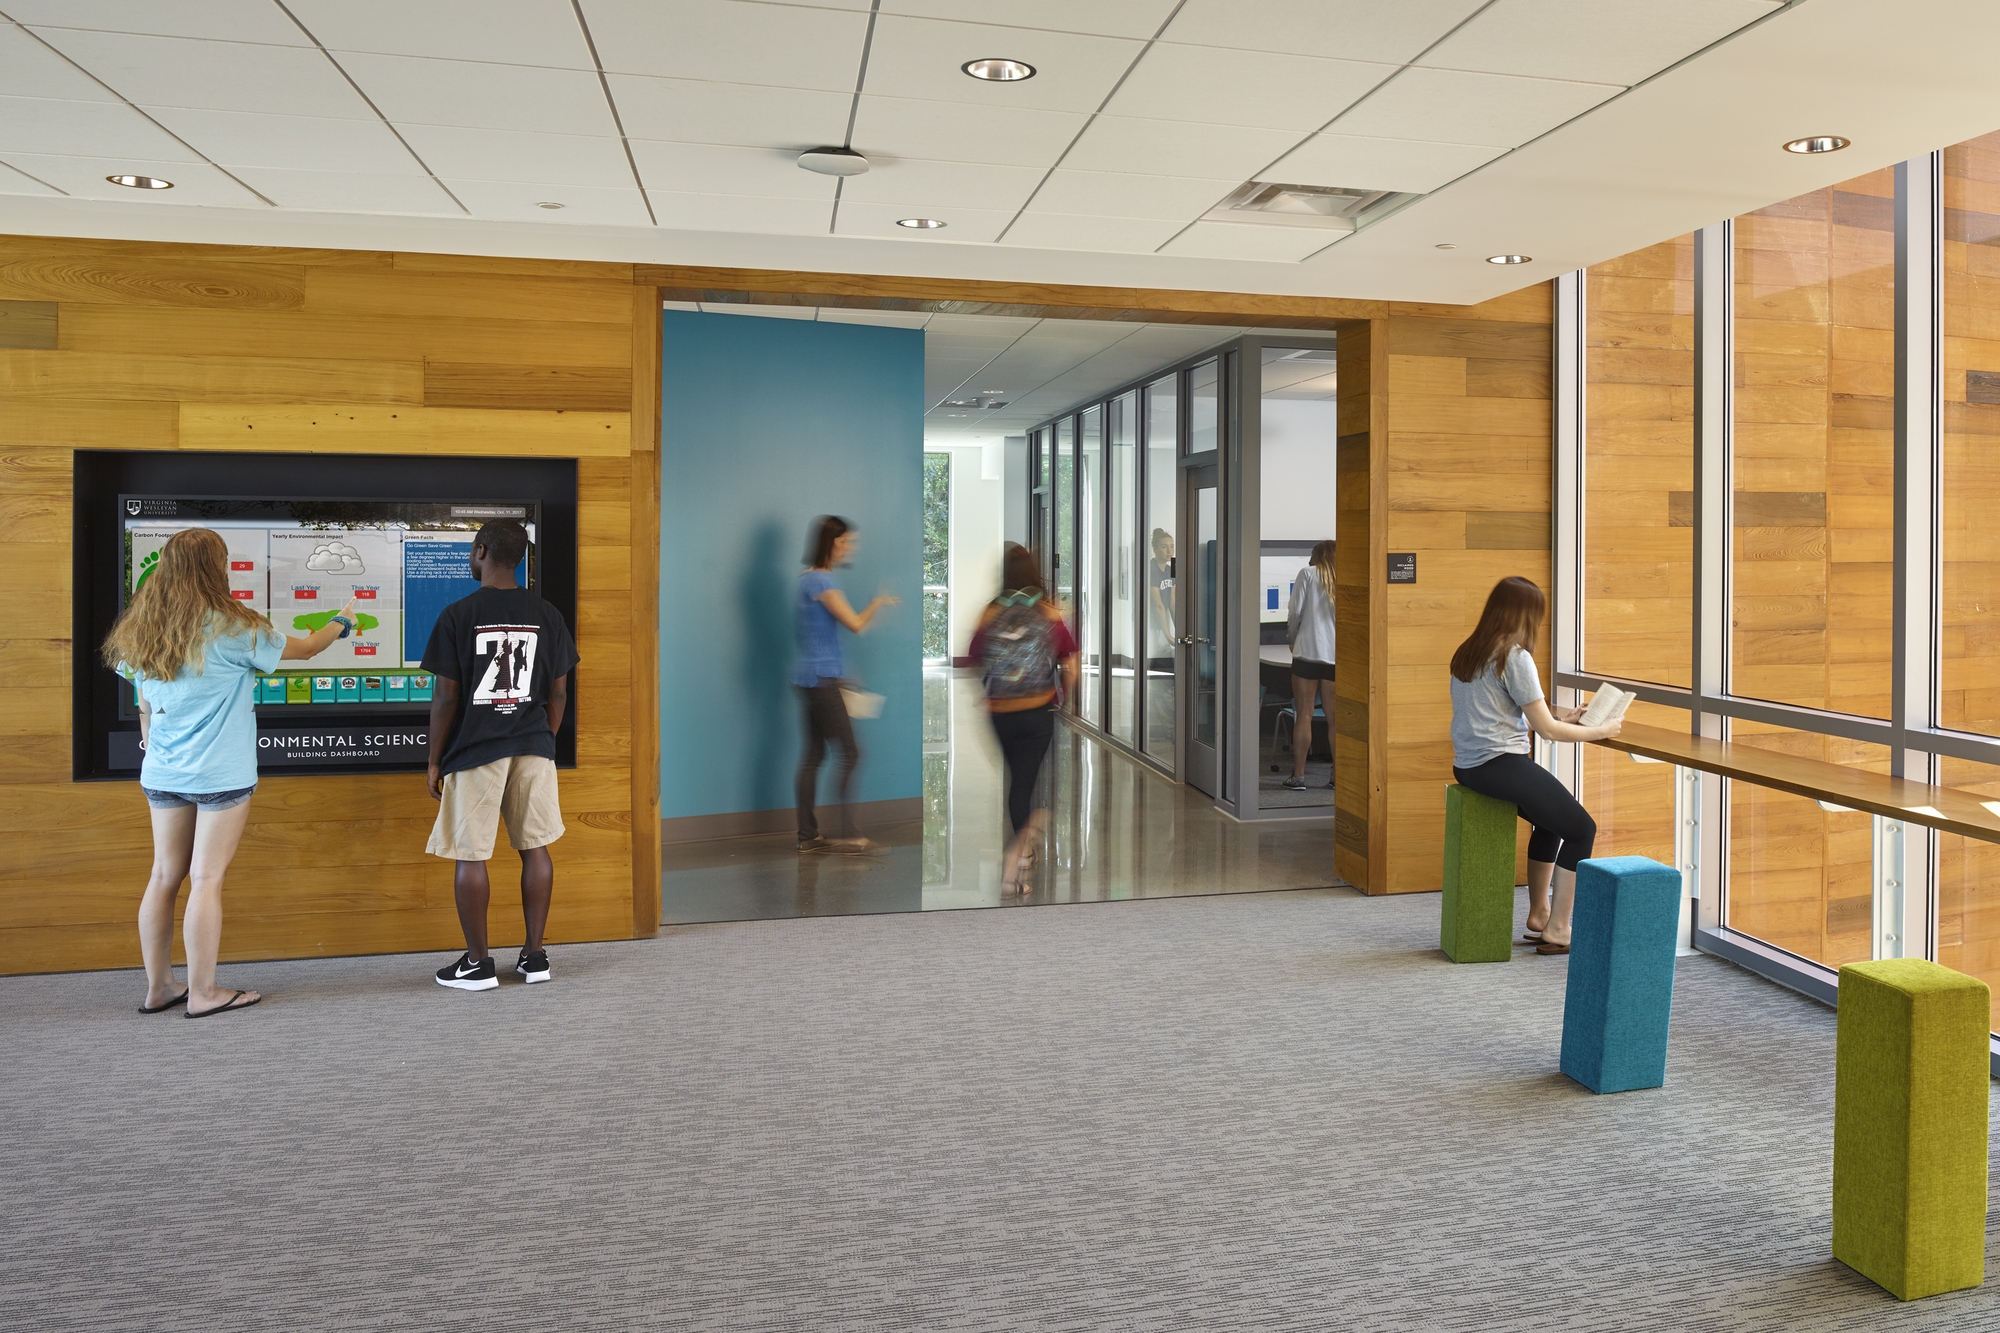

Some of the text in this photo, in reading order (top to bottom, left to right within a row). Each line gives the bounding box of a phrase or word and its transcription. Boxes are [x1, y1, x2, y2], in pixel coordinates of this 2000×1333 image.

[473, 631, 538, 699] 20
[258, 734, 427, 748] ONMENTAL SCIENC
